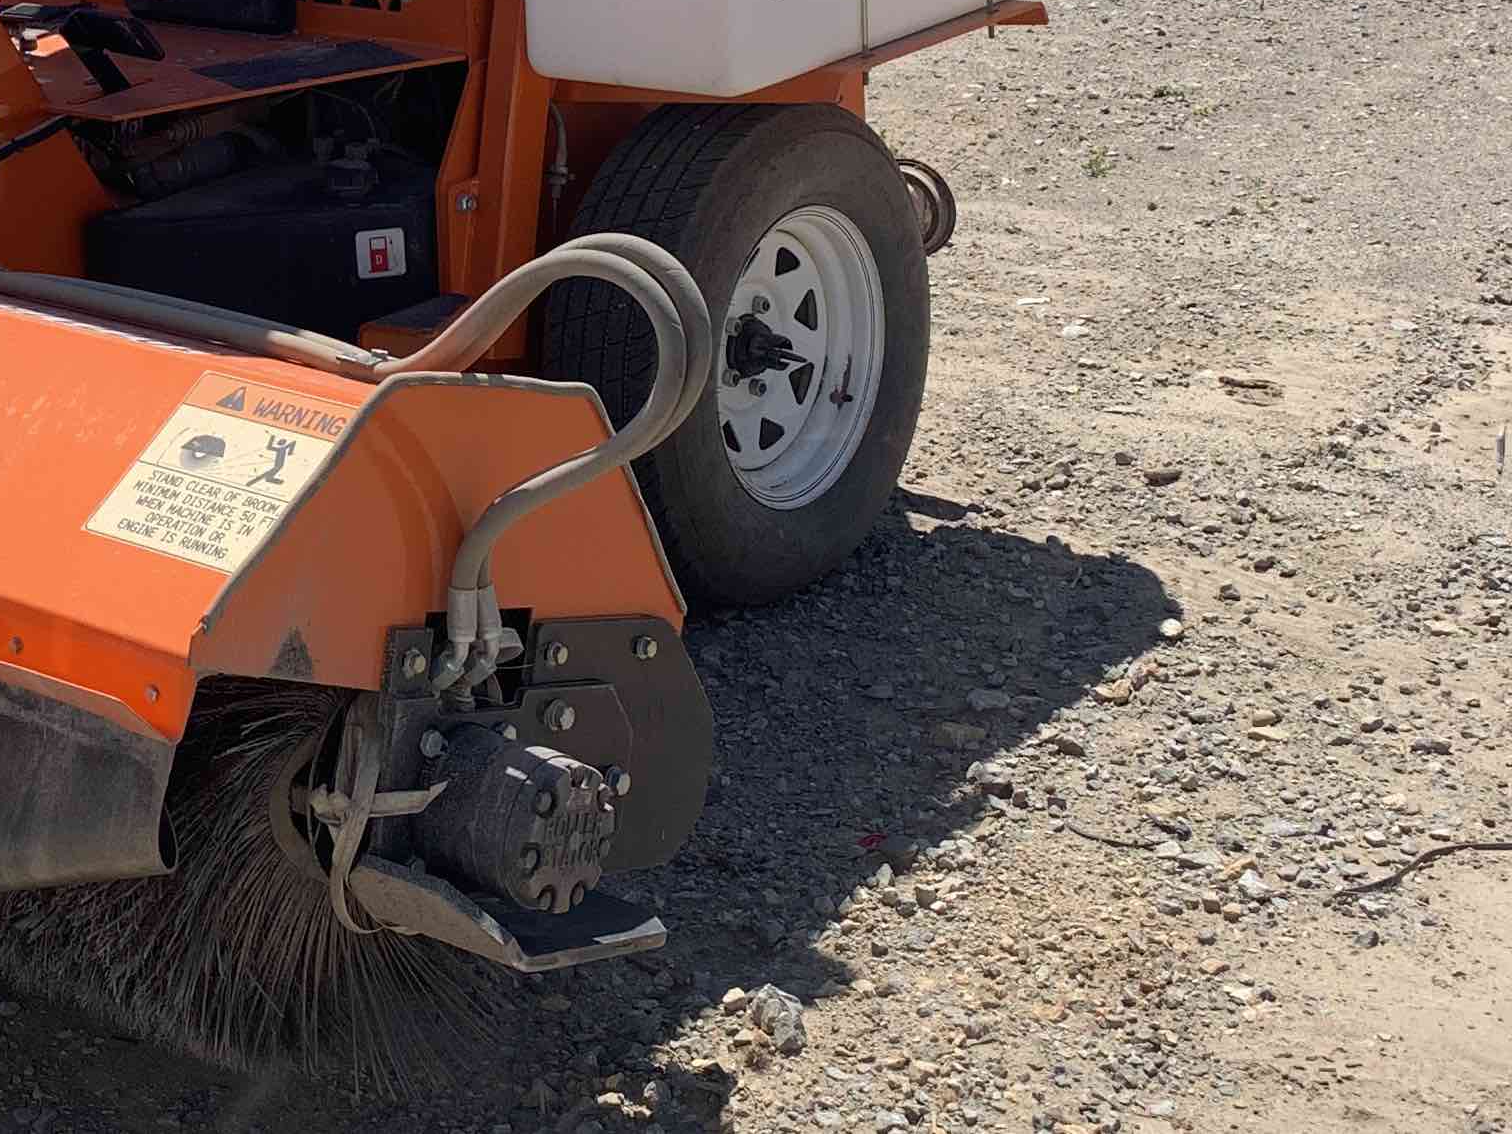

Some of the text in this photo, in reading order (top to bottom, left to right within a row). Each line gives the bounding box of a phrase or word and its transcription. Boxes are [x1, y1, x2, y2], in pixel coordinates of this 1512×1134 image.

[252, 396, 346, 436] WARNING
[134, 480, 180, 502] MINIMUM
[182, 493, 238, 517] DISTANCE
[239, 510, 256, 523] 50
[149, 470, 184, 488] STAND
[187, 480, 220, 498] CLEAR
[223, 490, 241, 503] OF
[136, 496, 255, 538] WHEN MACHINE IS IN
[144, 511, 226, 544] OPERATION OR
[117, 518, 229, 559] ENGINE IS RUNNING
